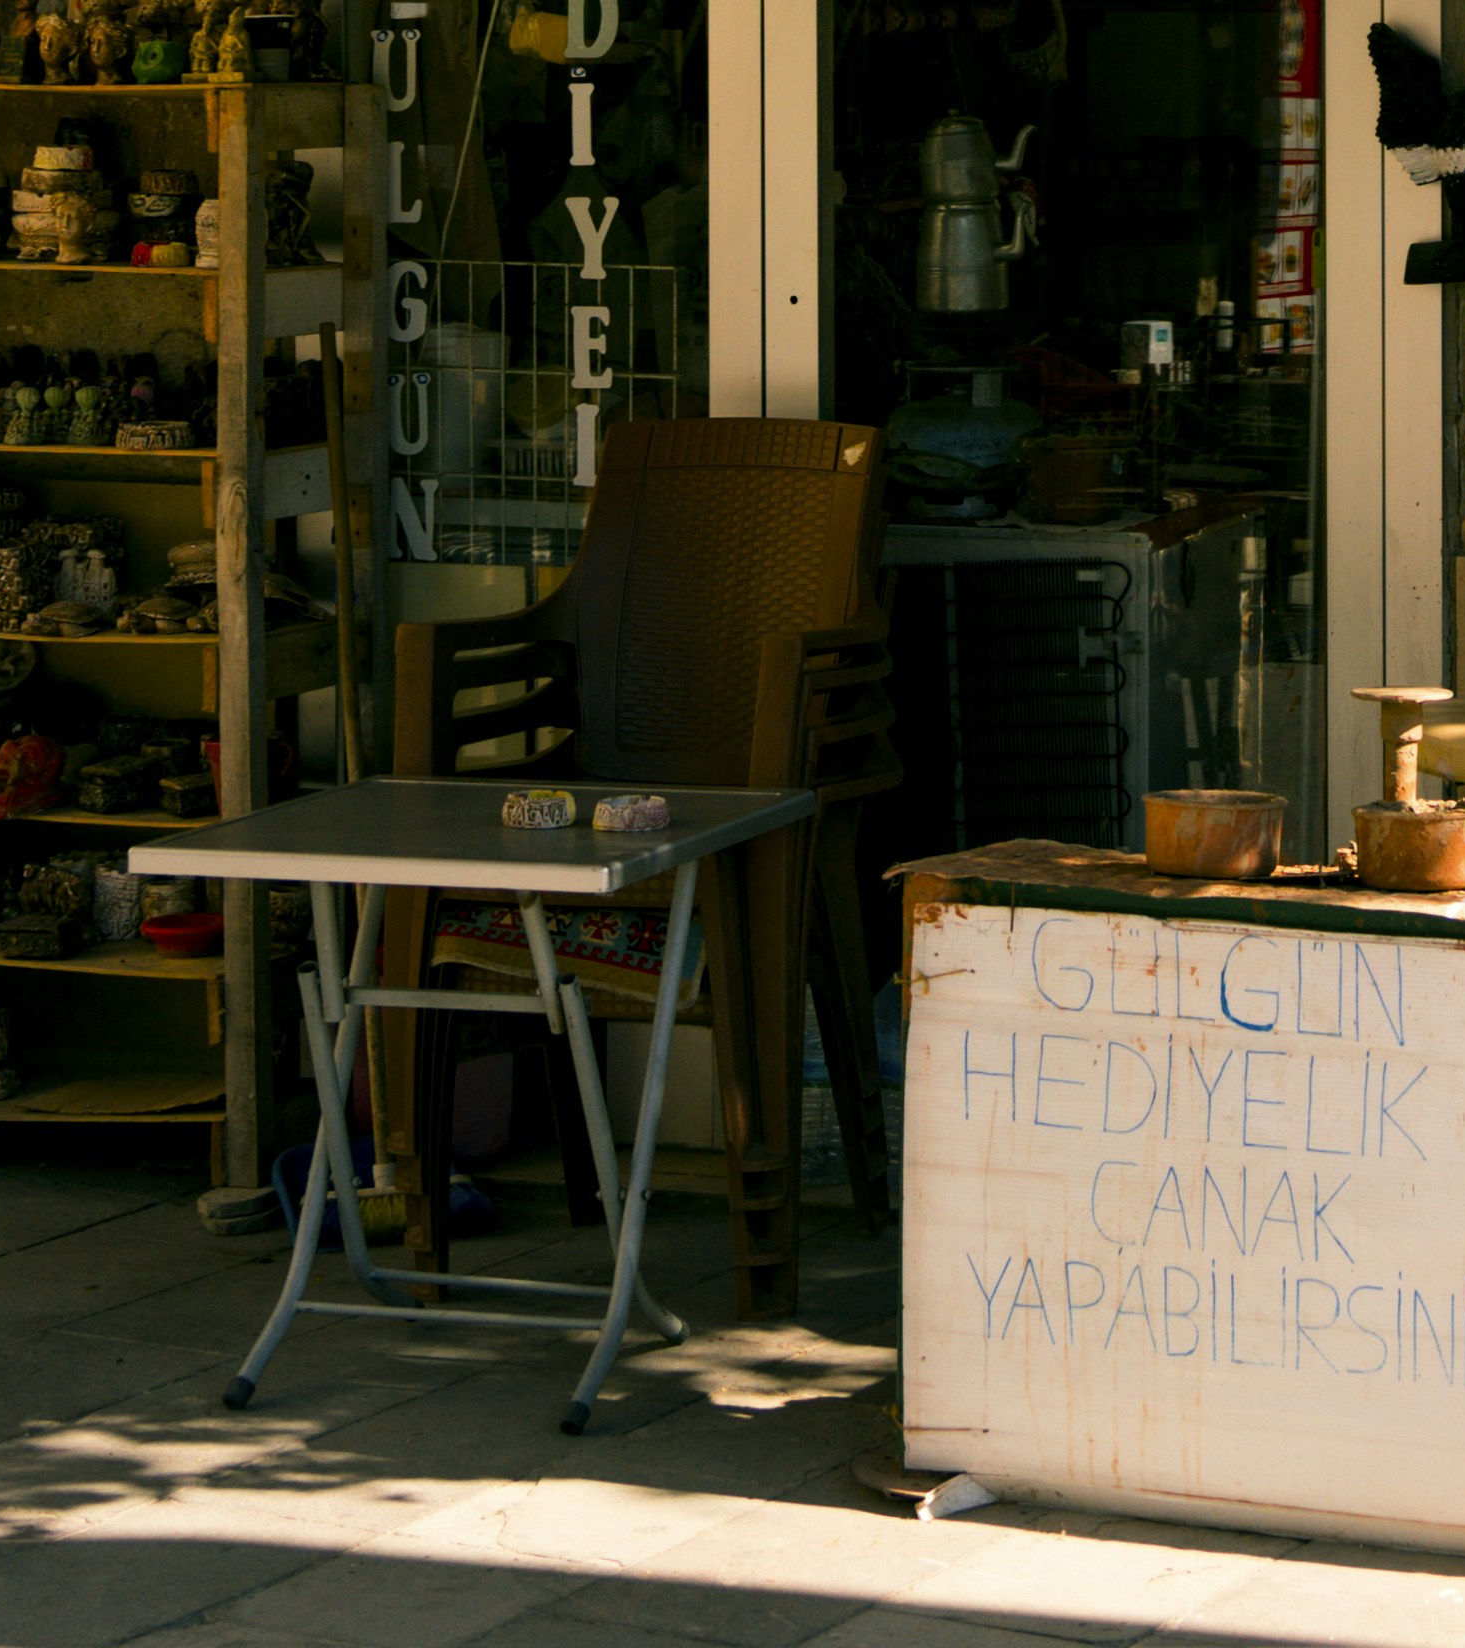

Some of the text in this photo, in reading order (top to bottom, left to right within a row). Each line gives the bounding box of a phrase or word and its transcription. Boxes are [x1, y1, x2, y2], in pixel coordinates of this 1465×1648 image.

[1032, 918, 1405, 1047] GÜLGÜN
[965, 1028, 1428, 1162] HEDİYELİK
[1091, 1160, 1355, 1265] ÇANAK
